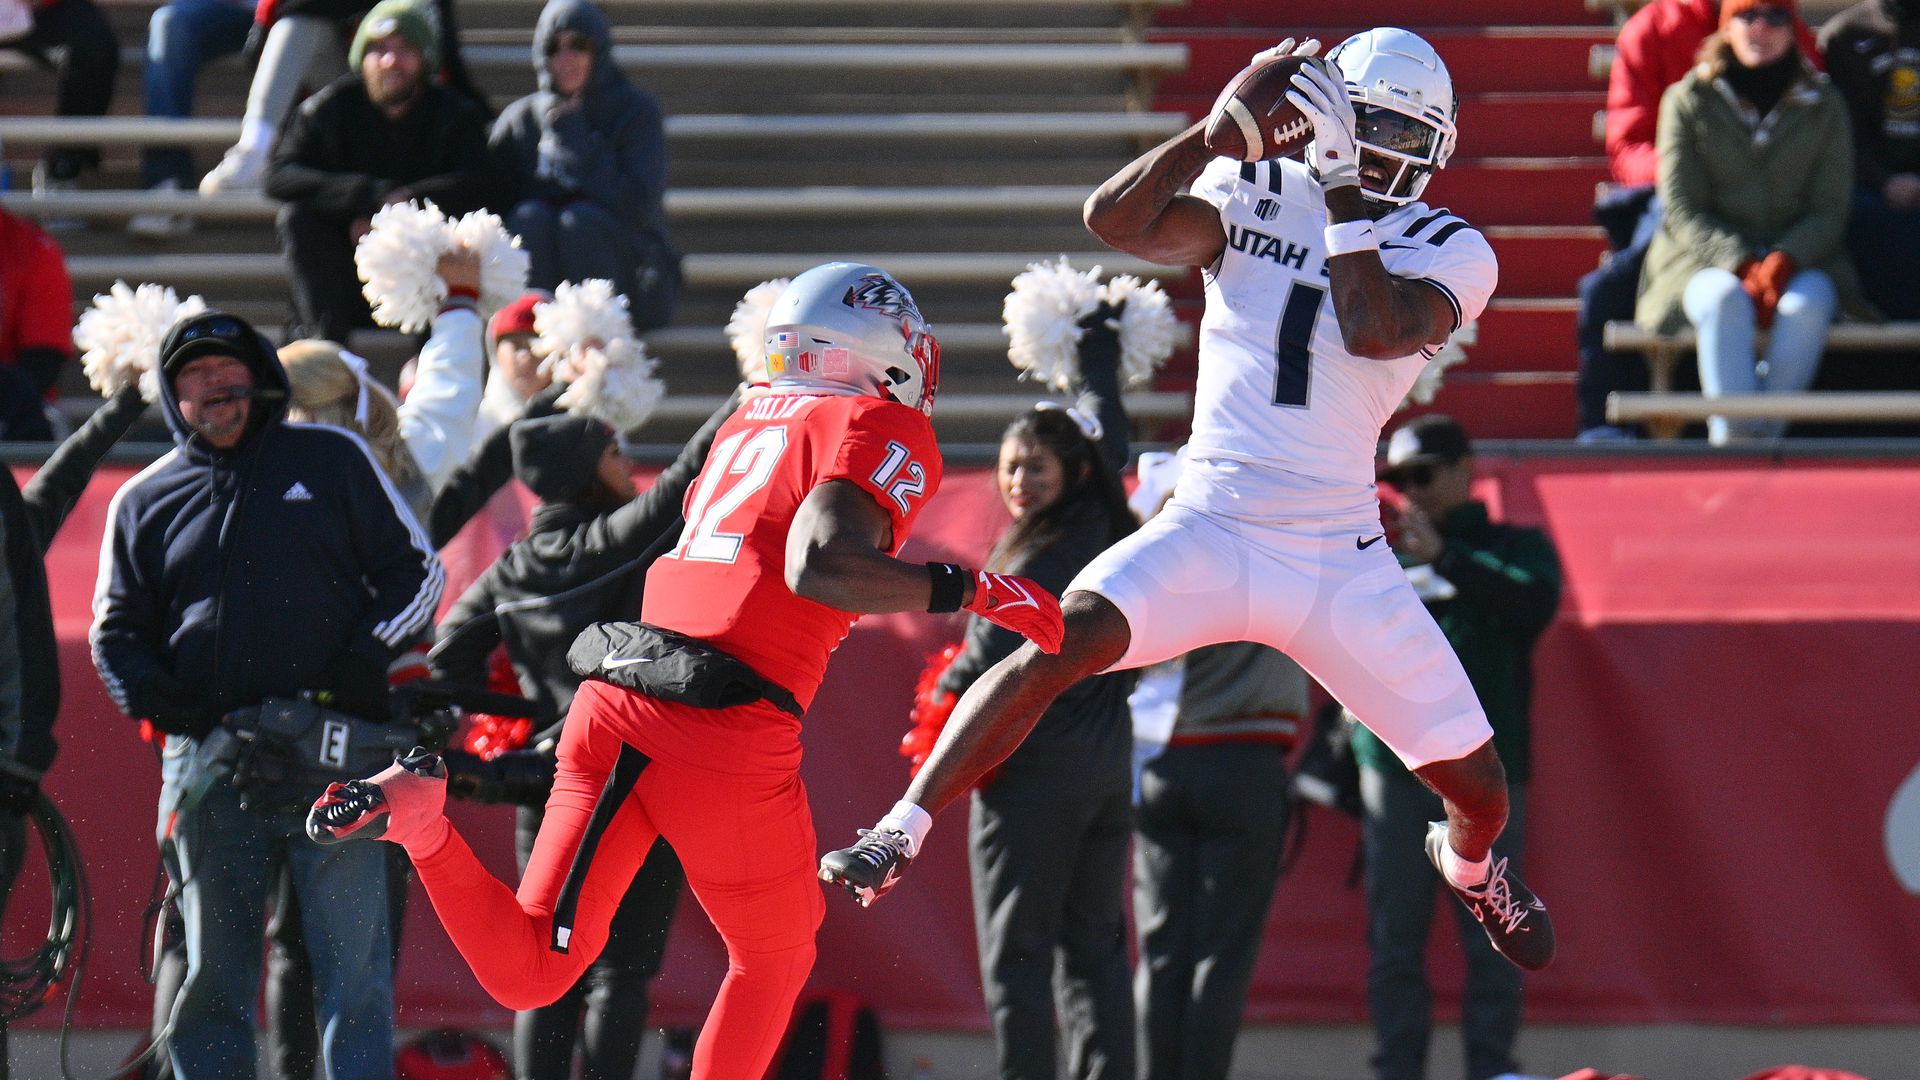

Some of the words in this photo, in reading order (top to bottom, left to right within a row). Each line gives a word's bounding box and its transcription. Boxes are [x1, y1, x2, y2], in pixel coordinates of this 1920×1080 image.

[1228, 221, 1310, 271] UTAH
[1271, 278, 1329, 410] 1
[661, 425, 788, 564] 12
[868, 439, 926, 518] 12
[324, 723, 346, 765] E
